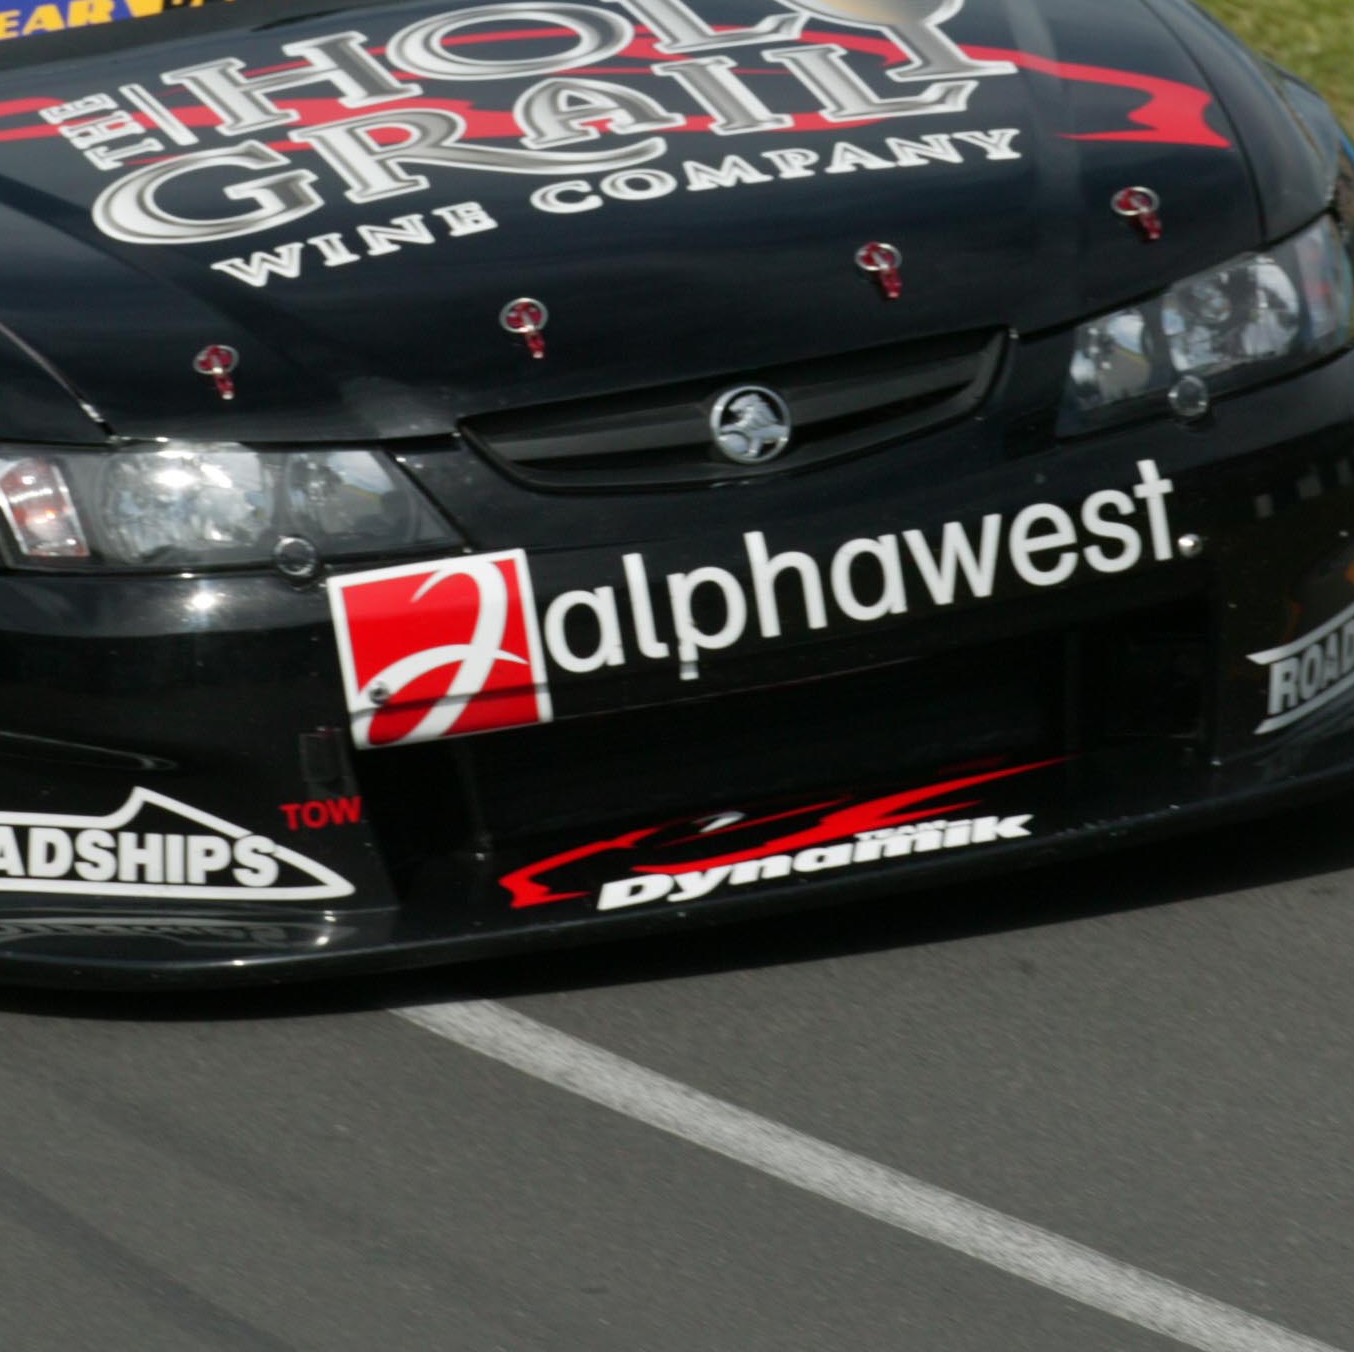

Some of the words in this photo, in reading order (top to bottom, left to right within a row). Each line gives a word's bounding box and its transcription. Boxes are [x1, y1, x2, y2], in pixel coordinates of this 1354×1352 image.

[38, 92, 165, 171] THE
[92, 44, 978, 245] GRAIL
[211, 201, 499, 288] WINE
[530, 128, 1021, 215] COMPANY
[280, 795, 362, 830] TOW
[597, 813, 1034, 911] Dynamik
